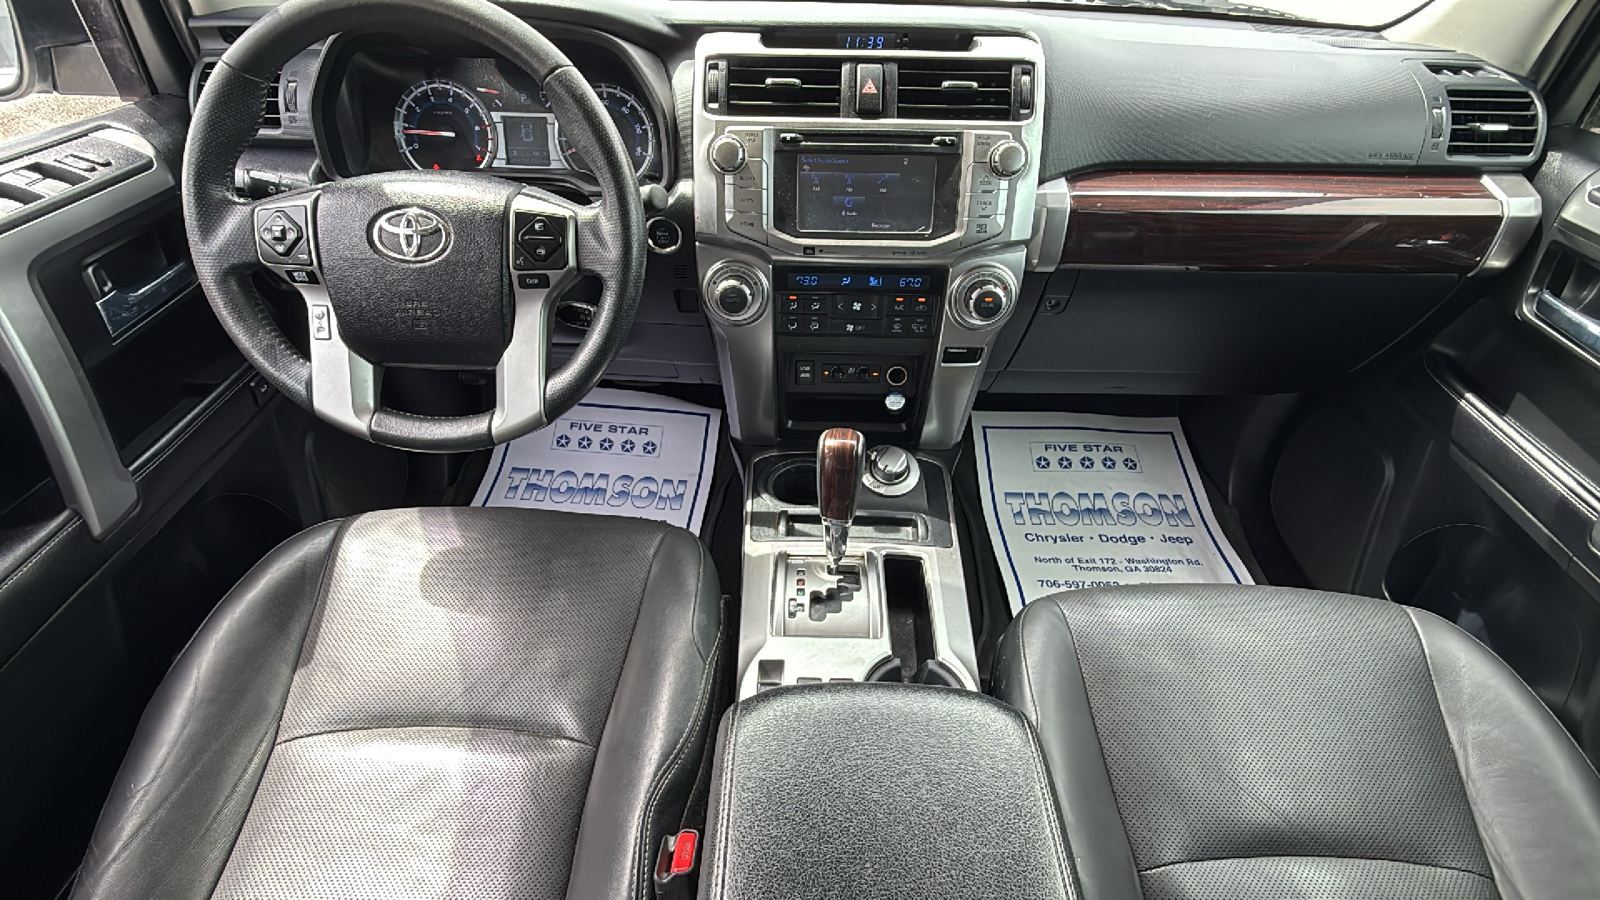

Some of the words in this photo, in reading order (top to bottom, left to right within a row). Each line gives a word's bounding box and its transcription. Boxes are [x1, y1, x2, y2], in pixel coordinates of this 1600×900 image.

[845, 36, 884, 49] 11:39
[569, 421, 603, 433] FIVE
[607, 424, 650, 436] STAR
[1044, 444, 1078, 452] FIVE
[1082, 444, 1124, 453] STAR
[504, 466, 688, 511] THOMSON
[1004, 491, 1196, 528] THOMSON
[1024, 532, 1084, 544] Chrysler
[1098, 533, 1147, 546] Dodge
[1160, 533, 1194, 546] Jeep
[1034, 556, 1062, 564] North
[1124, 557, 1185, 566] Washington
[1071, 564, 1124, 573] Thomson,
[1124, 565, 1142, 573] GA
[1142, 565, 1173, 573] 30824
